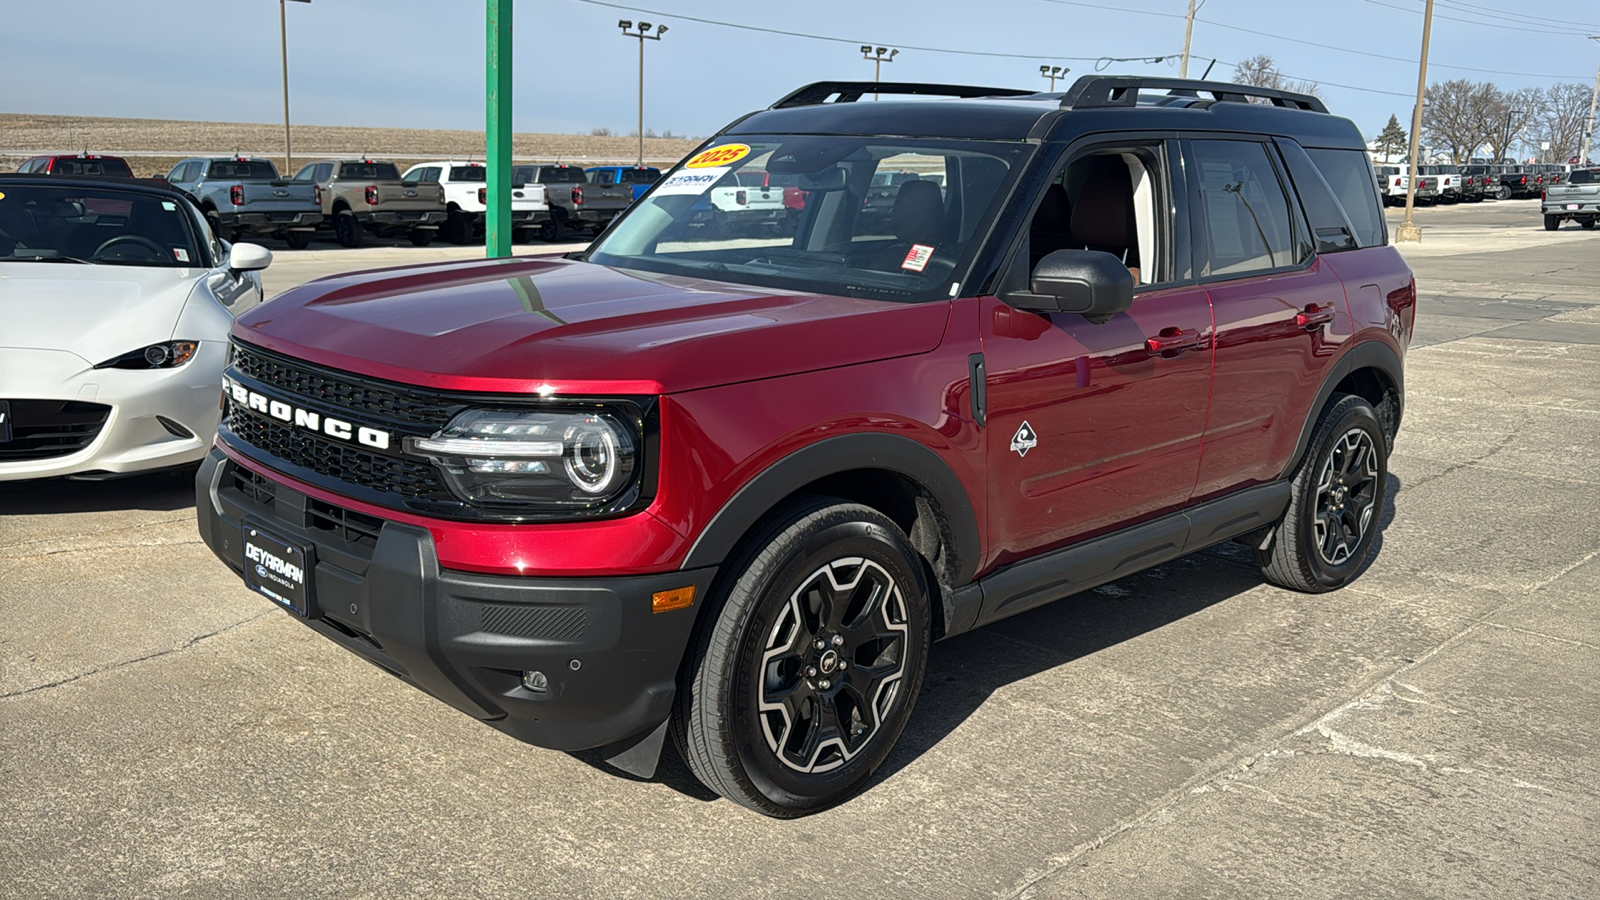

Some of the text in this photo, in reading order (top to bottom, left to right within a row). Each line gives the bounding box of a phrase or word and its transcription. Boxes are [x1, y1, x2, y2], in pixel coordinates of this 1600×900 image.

[688, 148, 746, 165] 2025
[232, 384, 389, 450] BRONCO
[245, 541, 304, 585] DEYARMAN
[267, 572, 295, 590] INDIANOLA
